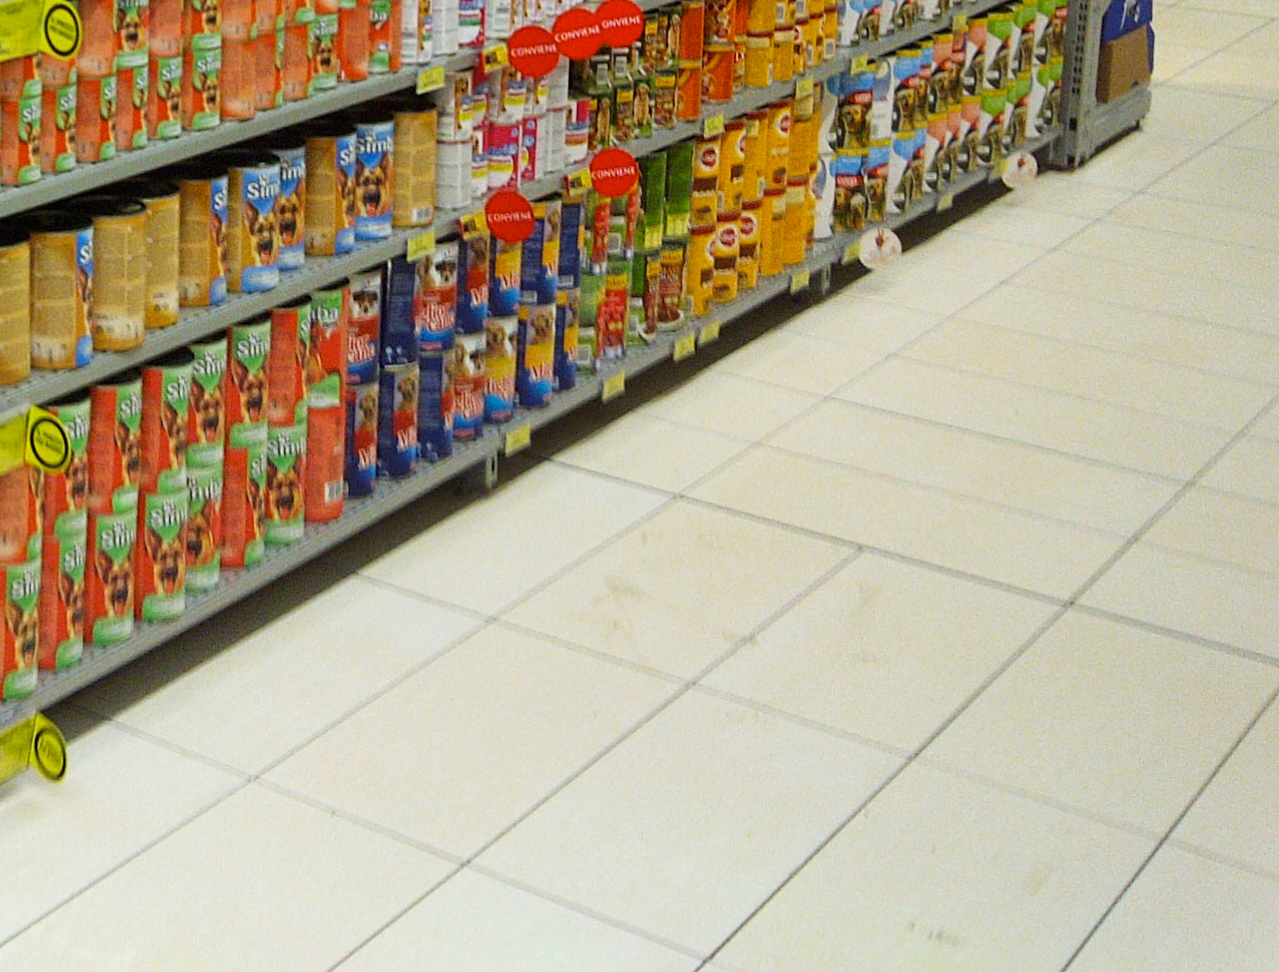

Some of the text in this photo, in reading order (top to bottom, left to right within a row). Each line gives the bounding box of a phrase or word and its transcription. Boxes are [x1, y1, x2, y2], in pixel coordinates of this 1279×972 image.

[601, 14, 642, 29] ONVIENE
[554, 25, 601, 43] CONVIENE
[510, 44, 558, 58] CONVIENE
[591, 166, 636, 179] CONVIENE
[487, 212, 533, 223] CONVIENE
